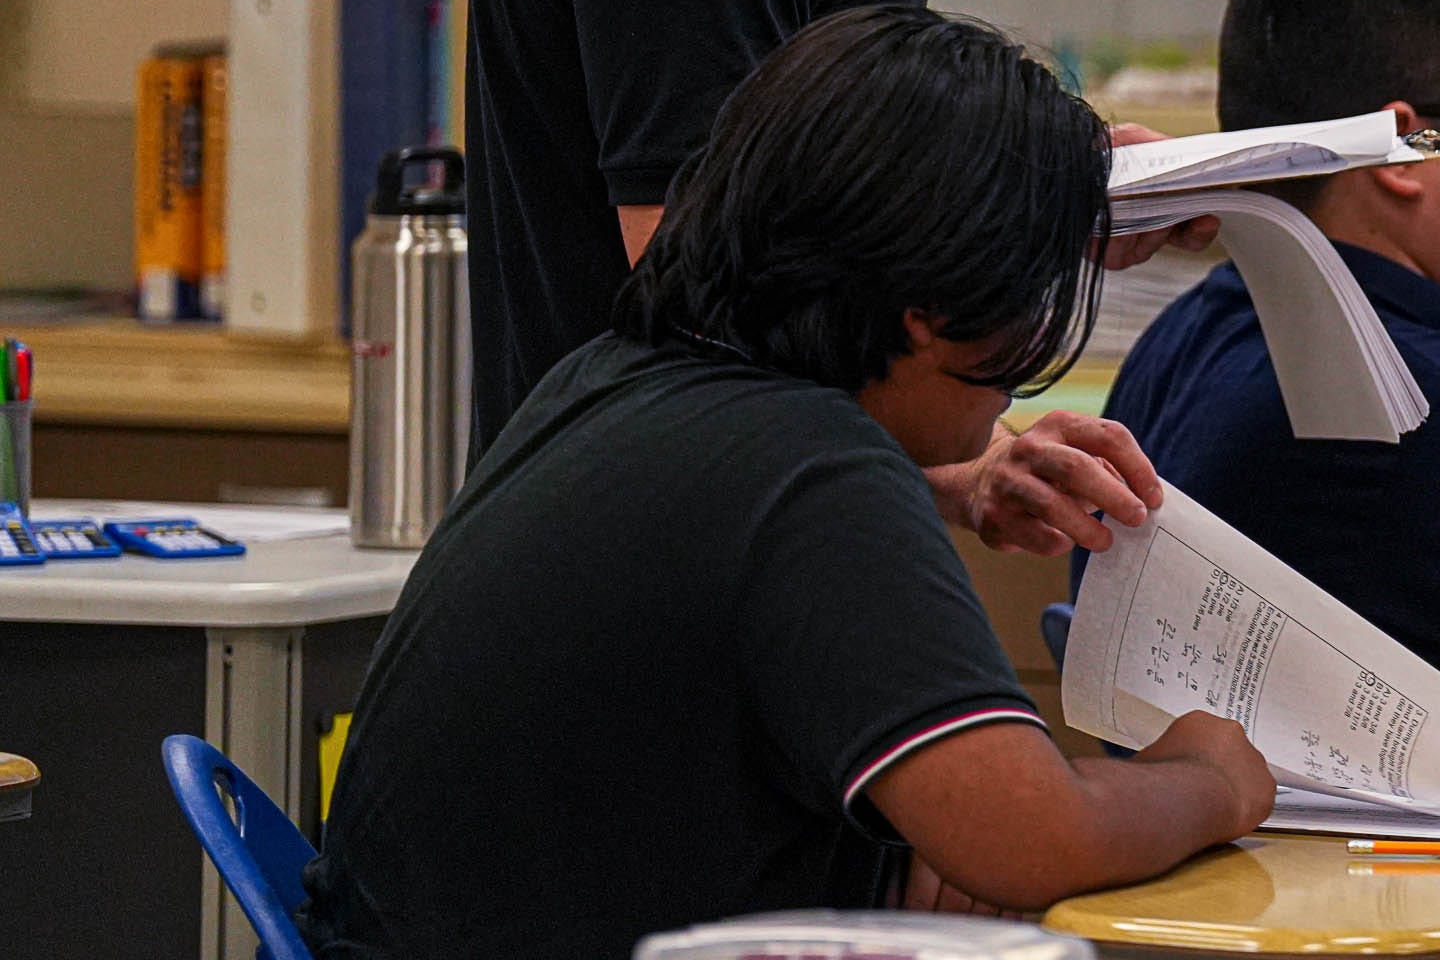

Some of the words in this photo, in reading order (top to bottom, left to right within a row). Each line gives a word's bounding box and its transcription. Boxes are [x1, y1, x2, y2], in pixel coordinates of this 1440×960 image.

[1201, 587, 1211, 602] and
[1221, 592, 1231, 604] 1/2
[1207, 598, 1217, 615] pies
[1217, 603, 1225, 617] pie
[1193, 614, 1201, 631] pies
[1225, 609, 1233, 622] pie
[1247, 601, 1265, 636] Calculate
[1260, 606, 1274, 628] Emily
[1264, 621, 1278, 643] Emily
[1241, 637, 1251, 653] how
[1252, 629, 1265, 653] baked
[1260, 644, 1268, 658] and
[1234, 653, 1244, 674] many
[1252, 659, 1263, 683] James
[1348, 689, 1357, 705] and
[1356, 694, 1365, 711] and
[1396, 698, 1407, 712] did
[1364, 699, 1374, 716] and
[1372, 705, 1382, 721] and
[1403, 703, 1414, 720] and
[1388, 712, 1400, 729] they
[1395, 720, 1407, 740] Liam
[1402, 718, 1418, 745] During
[1382, 730, 1393, 748] have
[1387, 740, 1400, 767] brought
